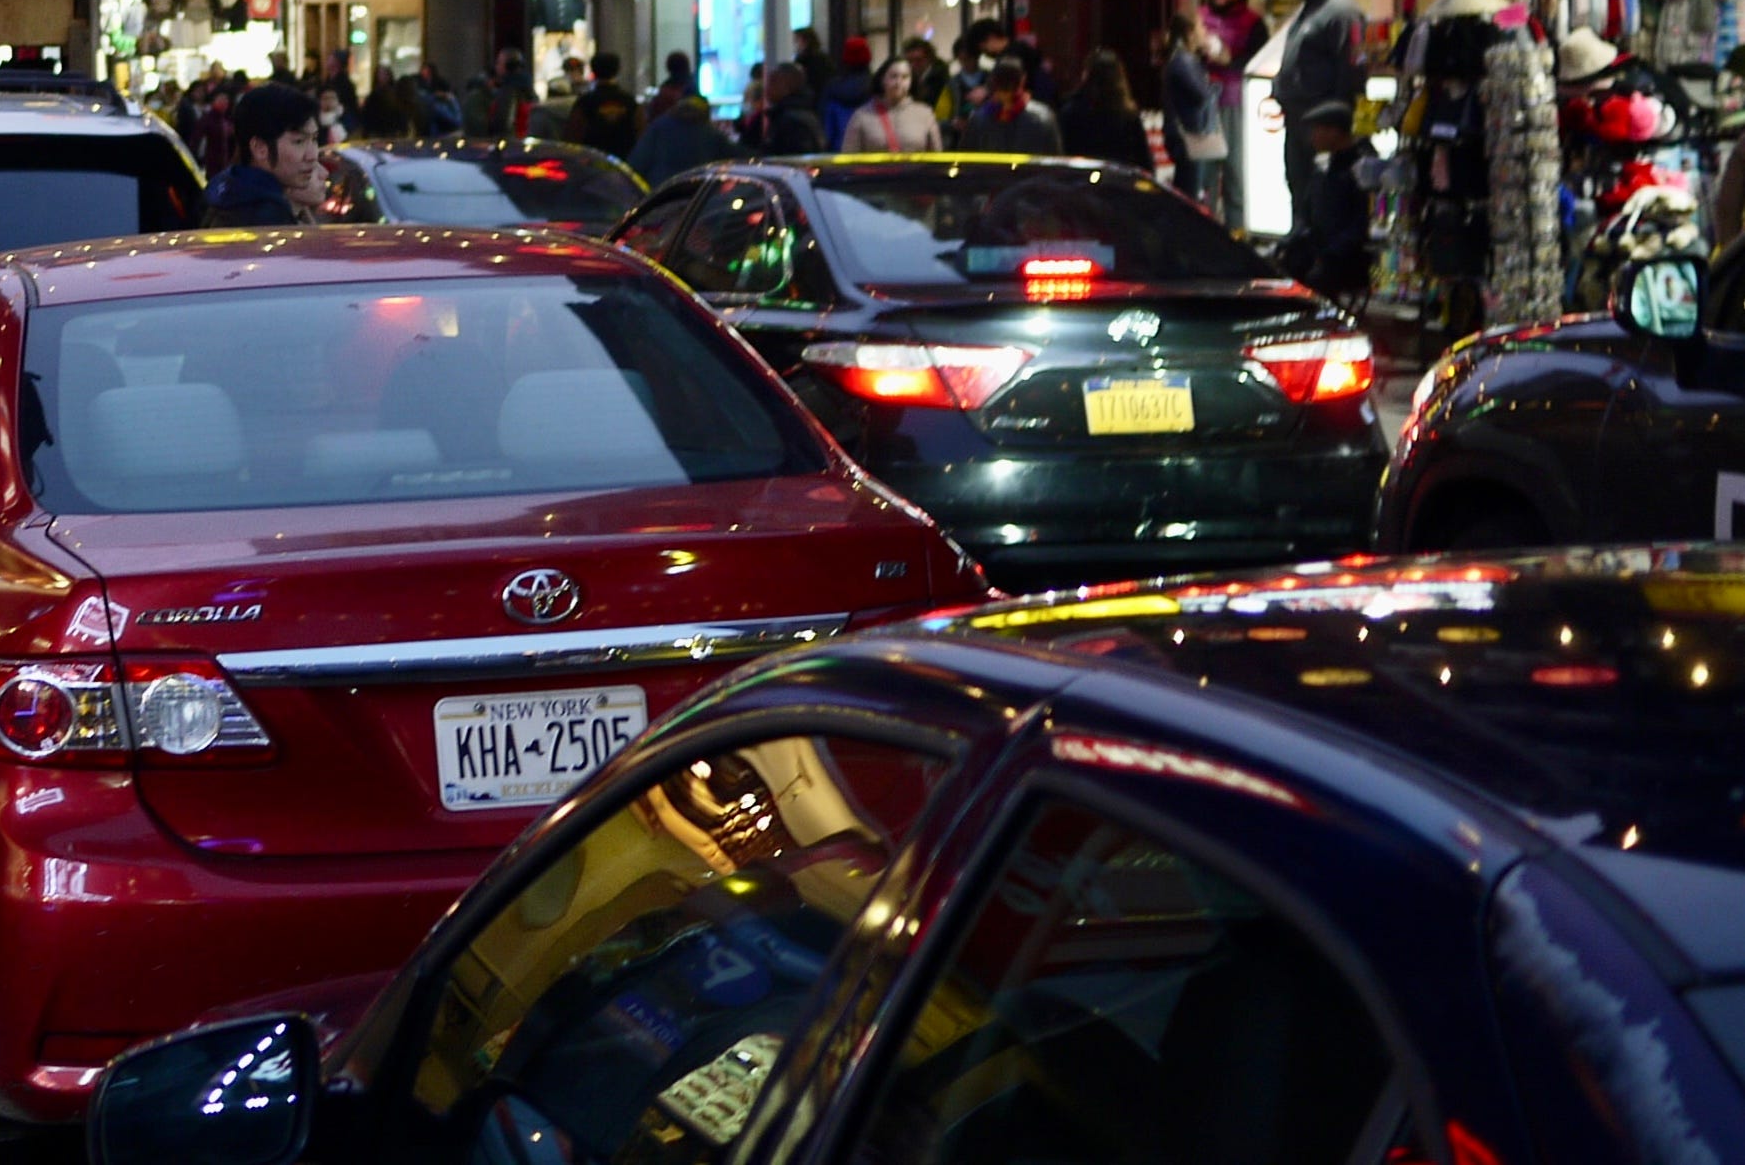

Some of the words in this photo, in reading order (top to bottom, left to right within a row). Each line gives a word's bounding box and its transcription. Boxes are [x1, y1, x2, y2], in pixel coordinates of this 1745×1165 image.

[136, 604, 263, 625] COROLLA
[489, 702, 536, 722] NEW
[539, 697, 593, 718] YORK
